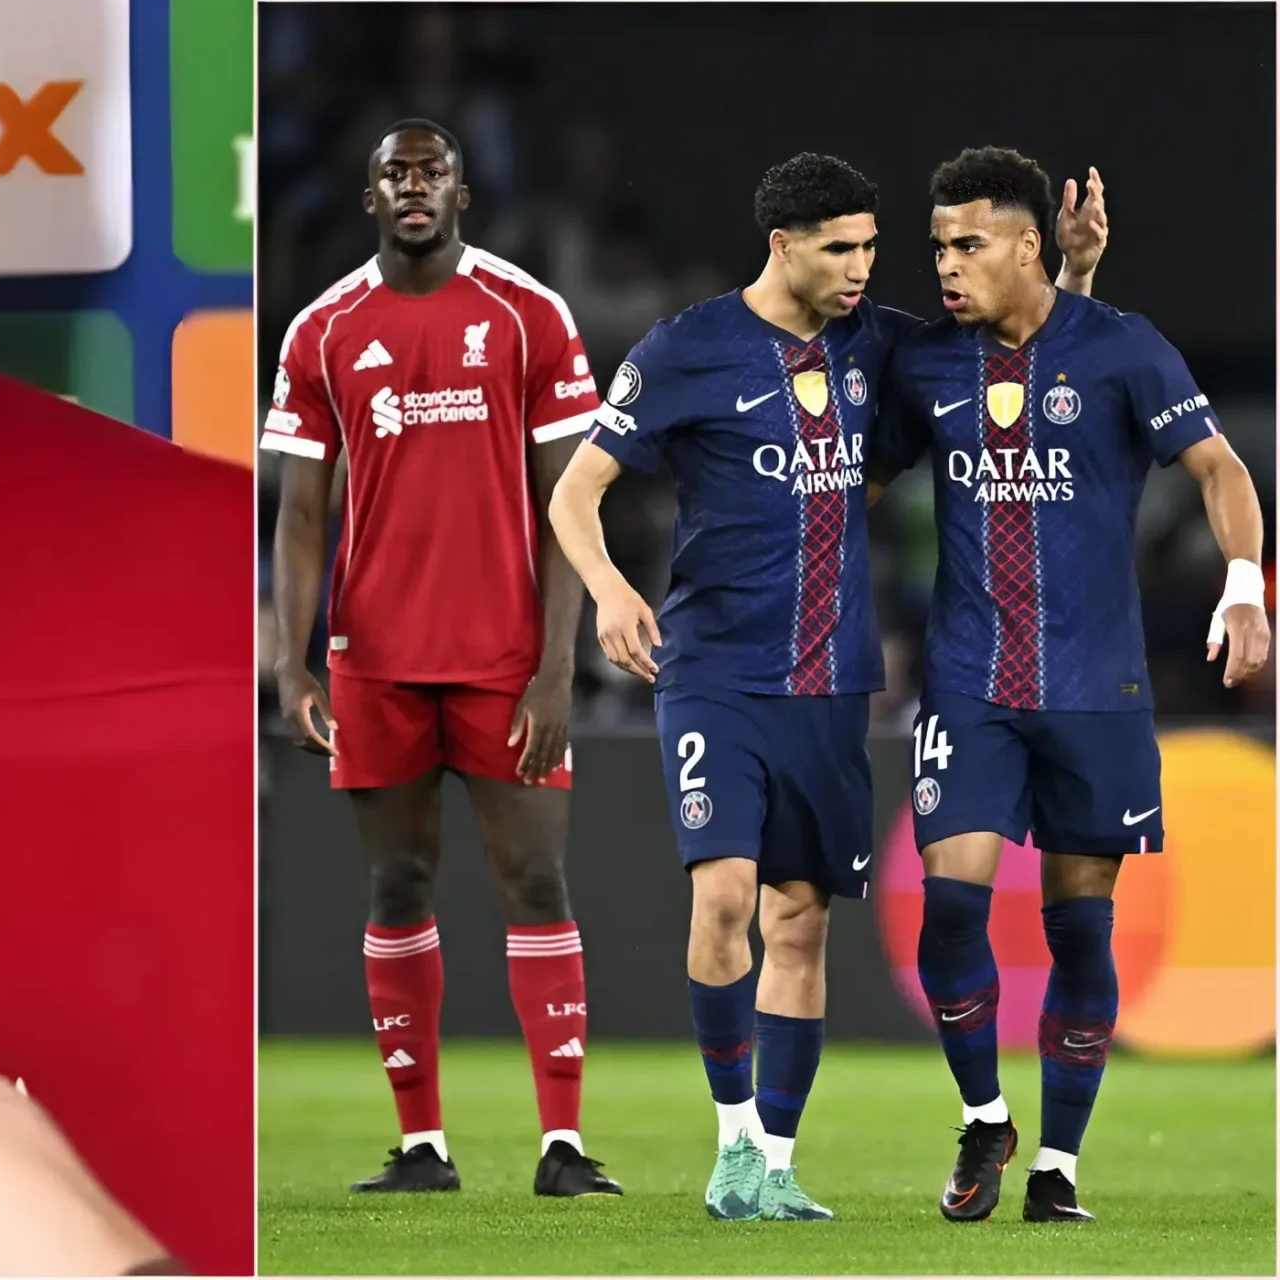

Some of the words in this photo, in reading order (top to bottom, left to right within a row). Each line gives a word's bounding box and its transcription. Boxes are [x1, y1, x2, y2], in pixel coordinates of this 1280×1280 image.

[753, 433, 863, 482] QATAR
[948, 448, 1073, 488] QATAR
[791, 467, 863, 495] AIRWAYS
[974, 482, 1074, 502] AIRWAYS
[677, 731, 706, 792] 2
[913, 714, 954, 779] 14
[373, 1014, 411, 1031] LFC
